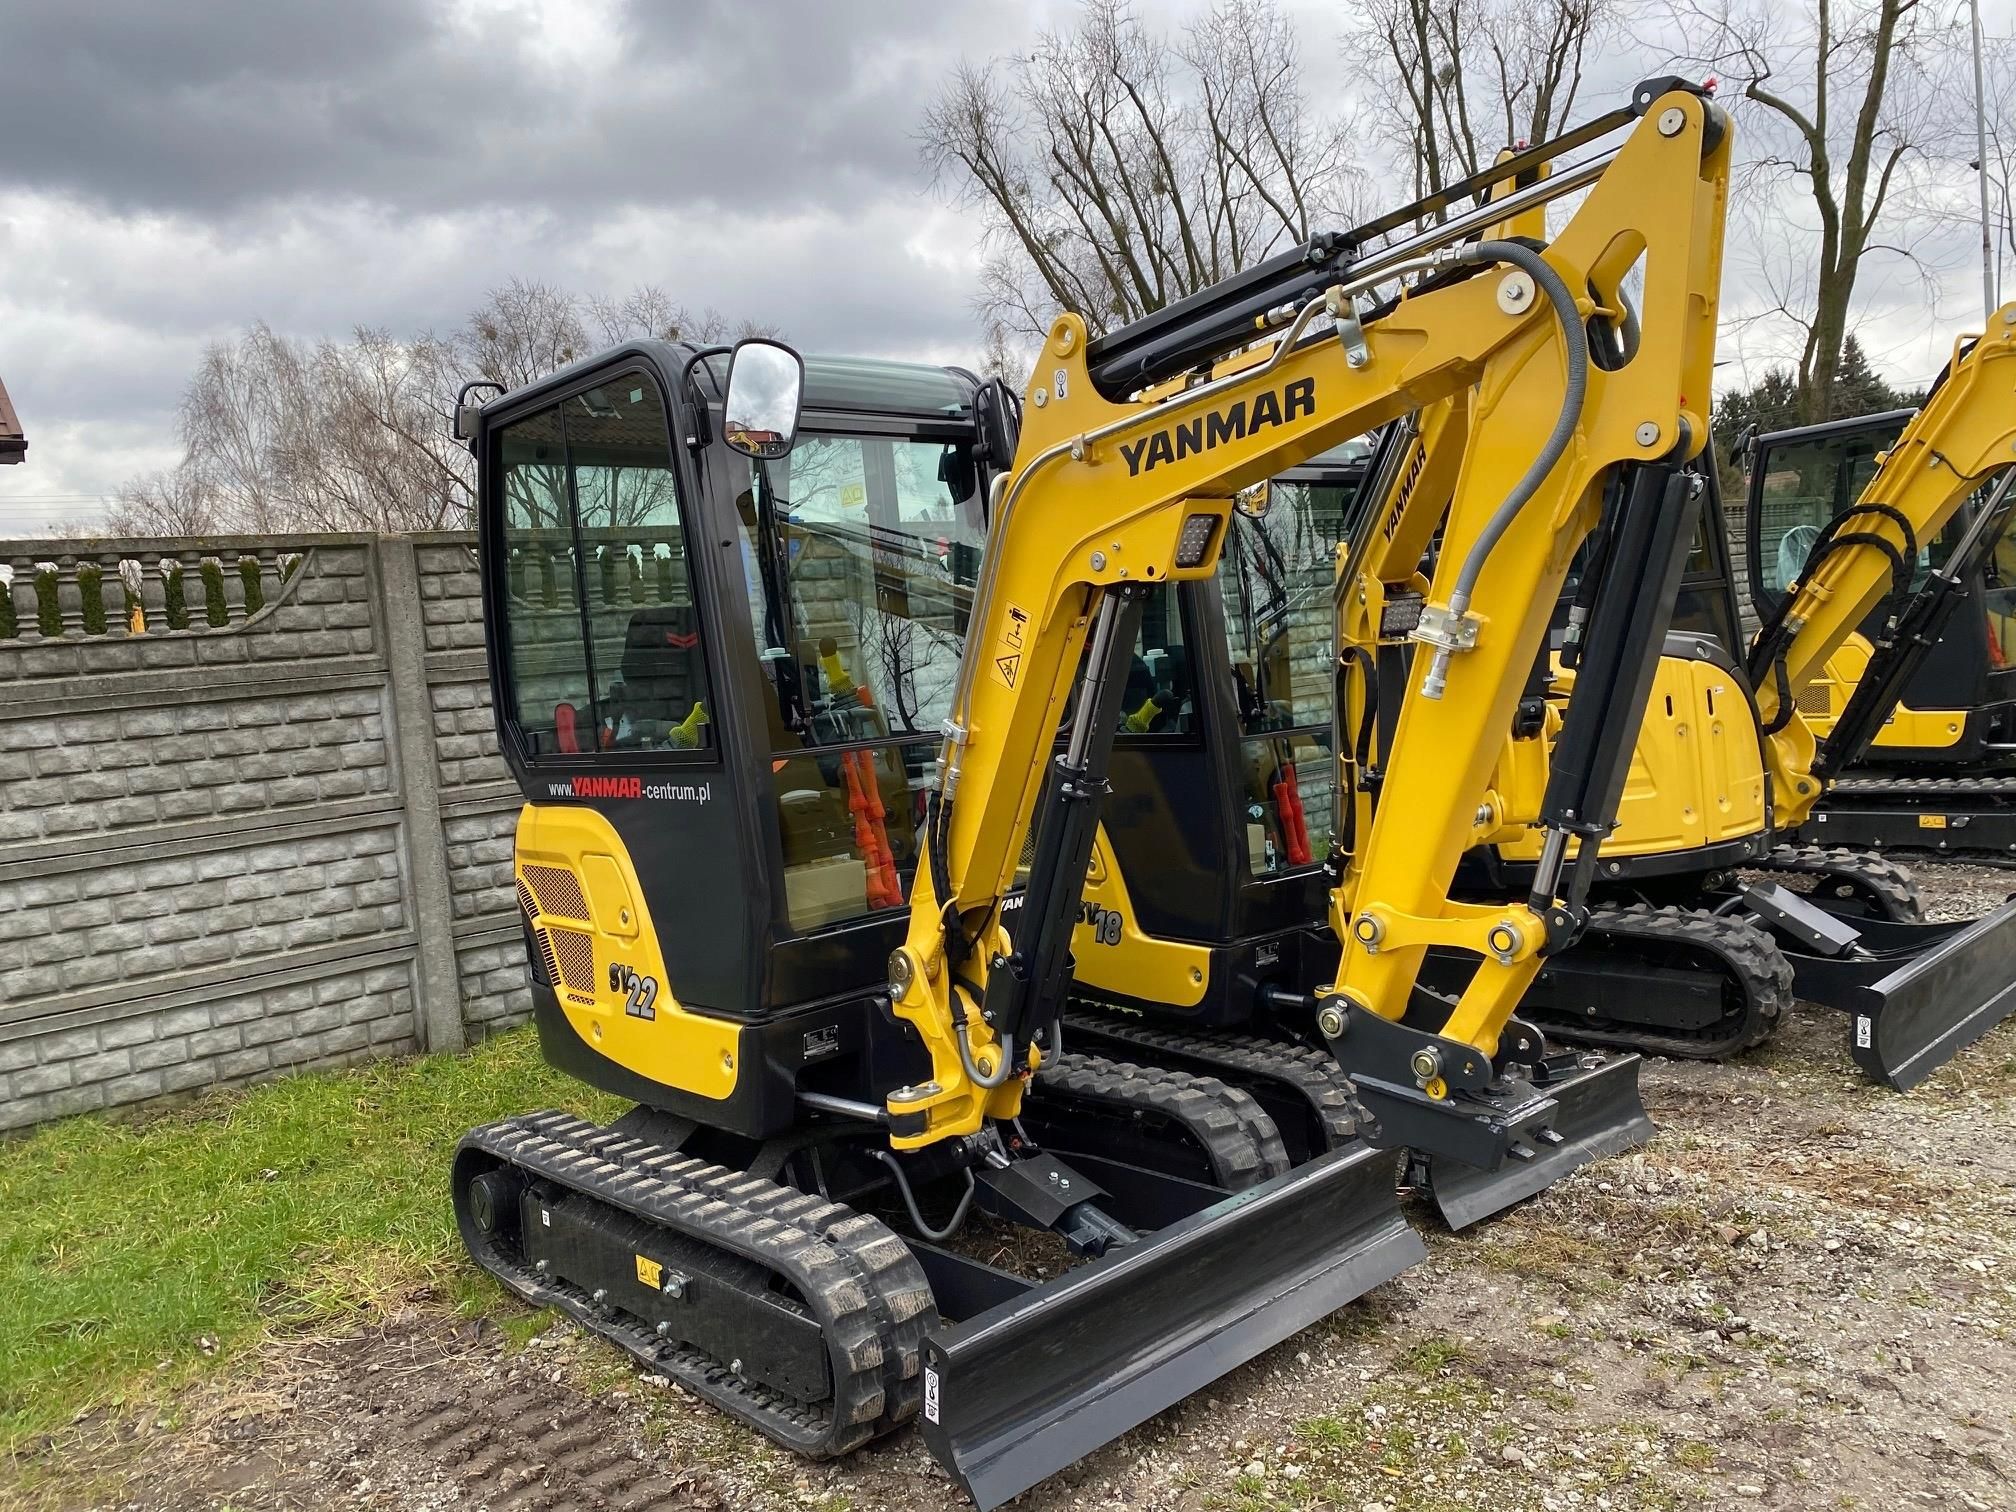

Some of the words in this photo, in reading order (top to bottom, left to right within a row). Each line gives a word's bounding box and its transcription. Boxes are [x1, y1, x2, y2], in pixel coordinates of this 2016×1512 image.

[1119, 376, 1315, 477] YANMAR
[1383, 440, 1426, 544] YANMAR
[549, 777, 711, 805] www.YANMAR-centrum.pl
[609, 963, 658, 1021] SV22
